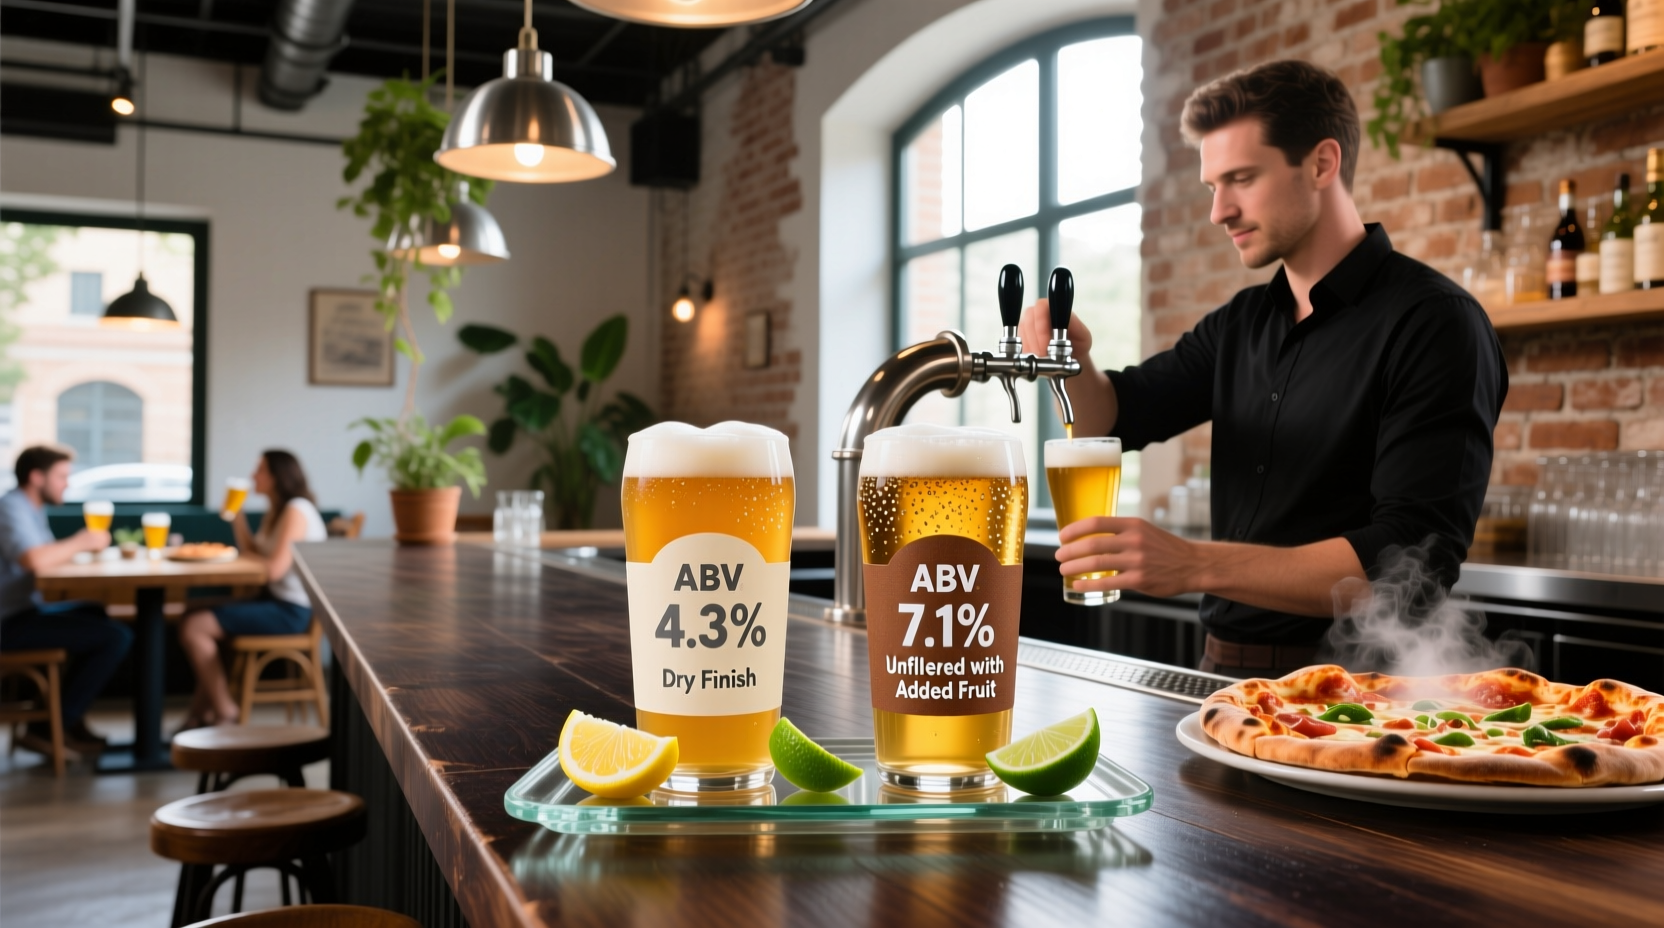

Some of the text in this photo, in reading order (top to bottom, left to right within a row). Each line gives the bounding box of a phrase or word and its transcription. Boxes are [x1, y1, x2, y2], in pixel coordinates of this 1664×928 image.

[673, 563, 744, 592] ABV
[910, 563, 981, 593] ABV
[655, 602, 767, 649] 4.3%
[898, 603, 995, 648] 7.1%
[970, 655, 1005, 675] with
[662, 667, 757, 694] Dry Finish
[895, 680, 997, 700] Added Fruit
